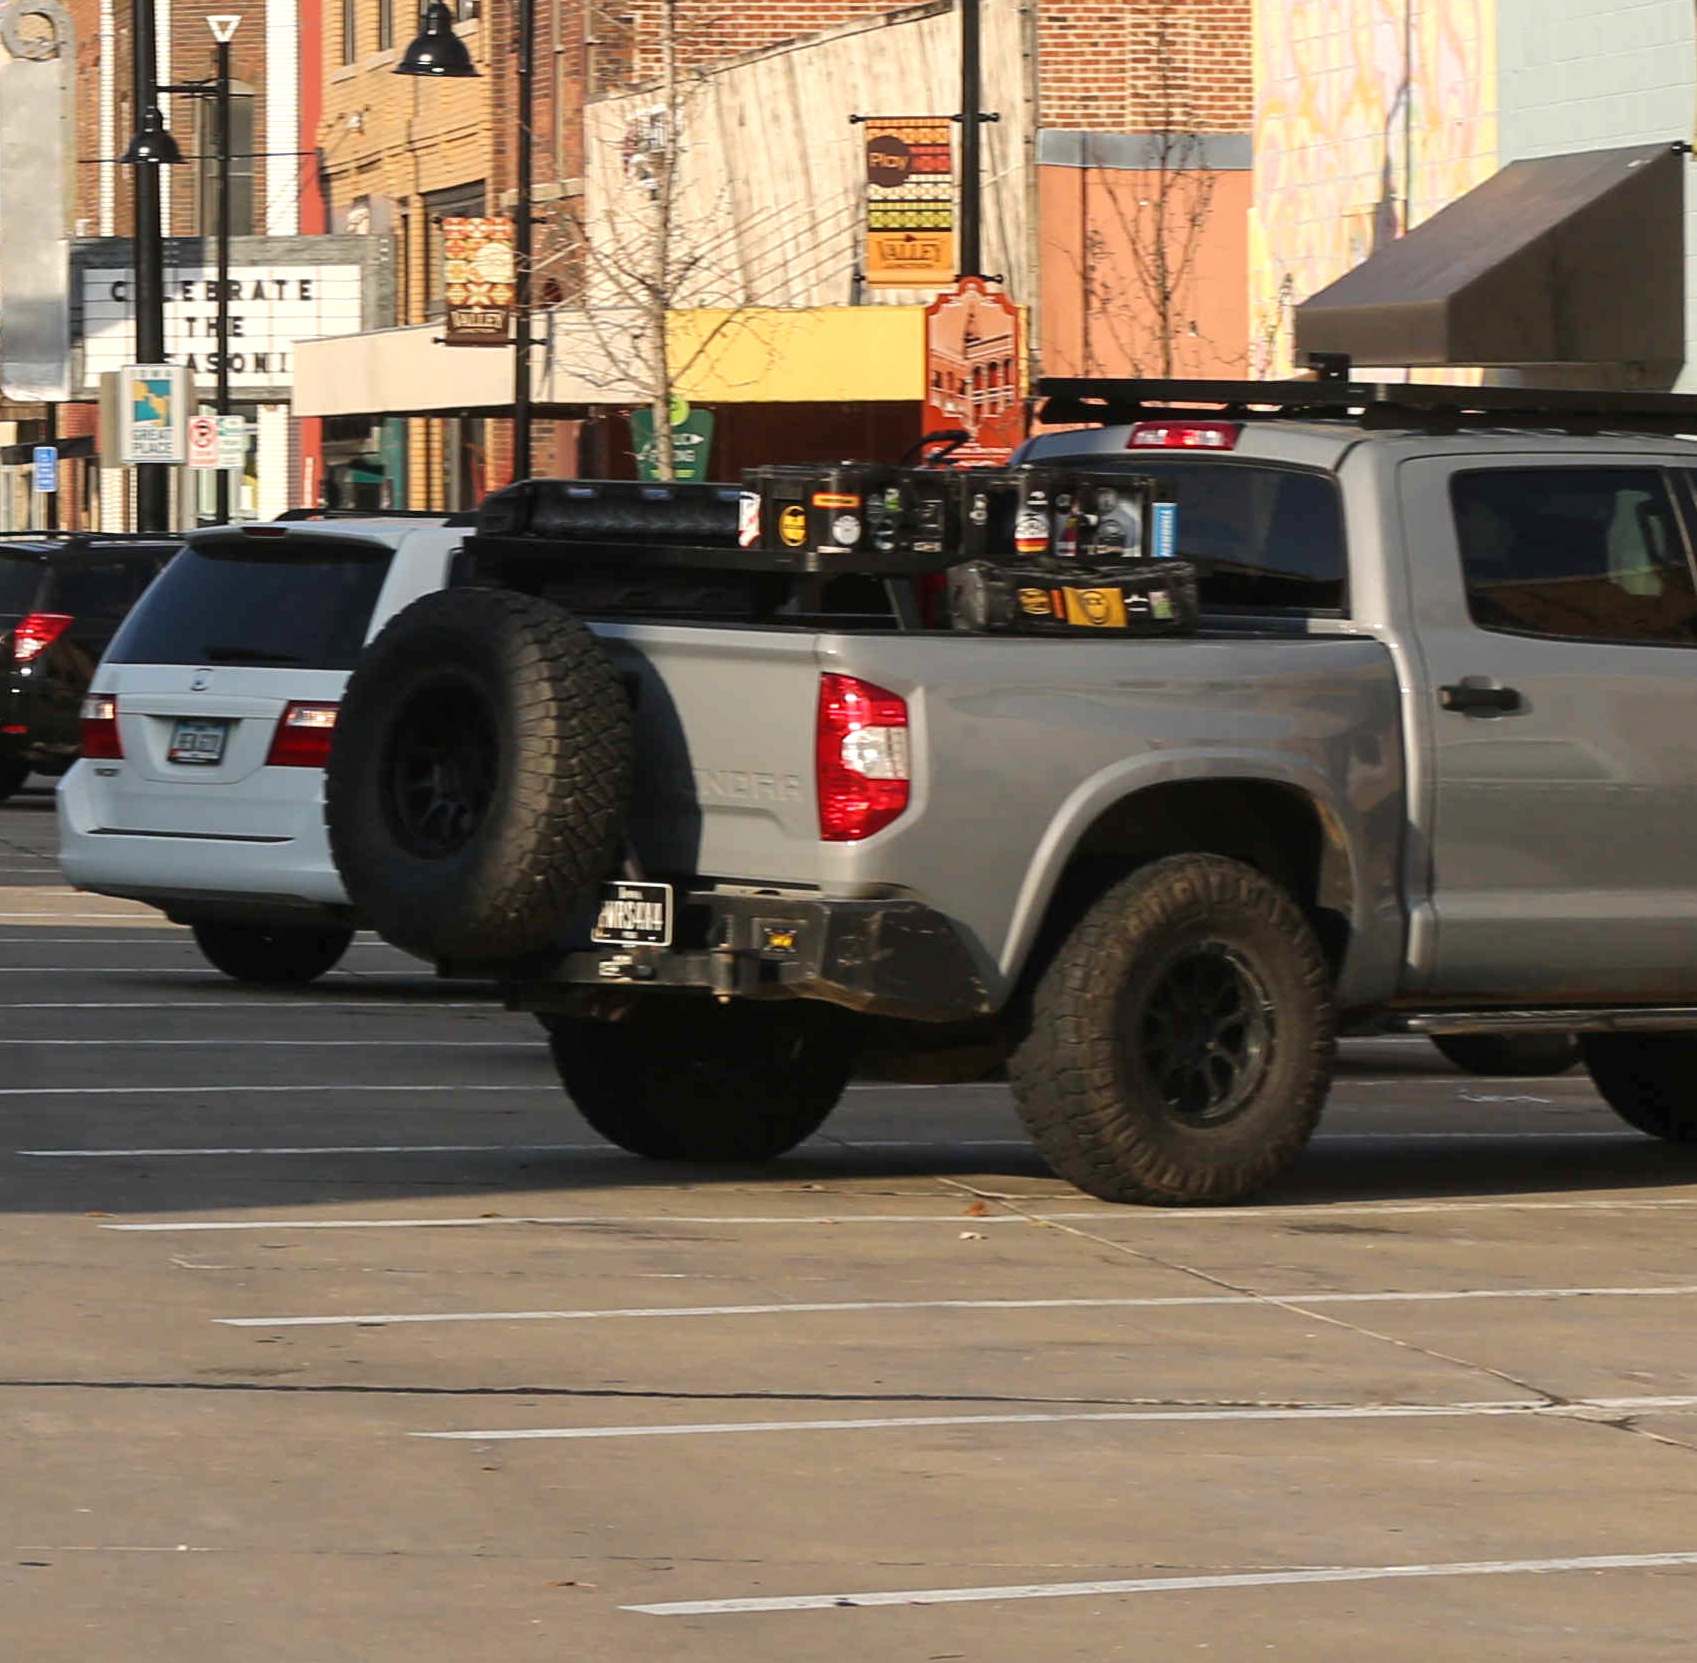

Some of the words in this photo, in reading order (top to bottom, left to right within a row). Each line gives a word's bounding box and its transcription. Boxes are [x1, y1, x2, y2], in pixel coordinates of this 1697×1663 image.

[869, 152, 911, 171] Play
[877, 241, 942, 263] VALLEY
[111, 280, 312, 302] CEBRATE
[185, 317, 245, 337] THE
[132, 428, 173, 441] GREAT
[132, 442, 173, 454] PLACE
